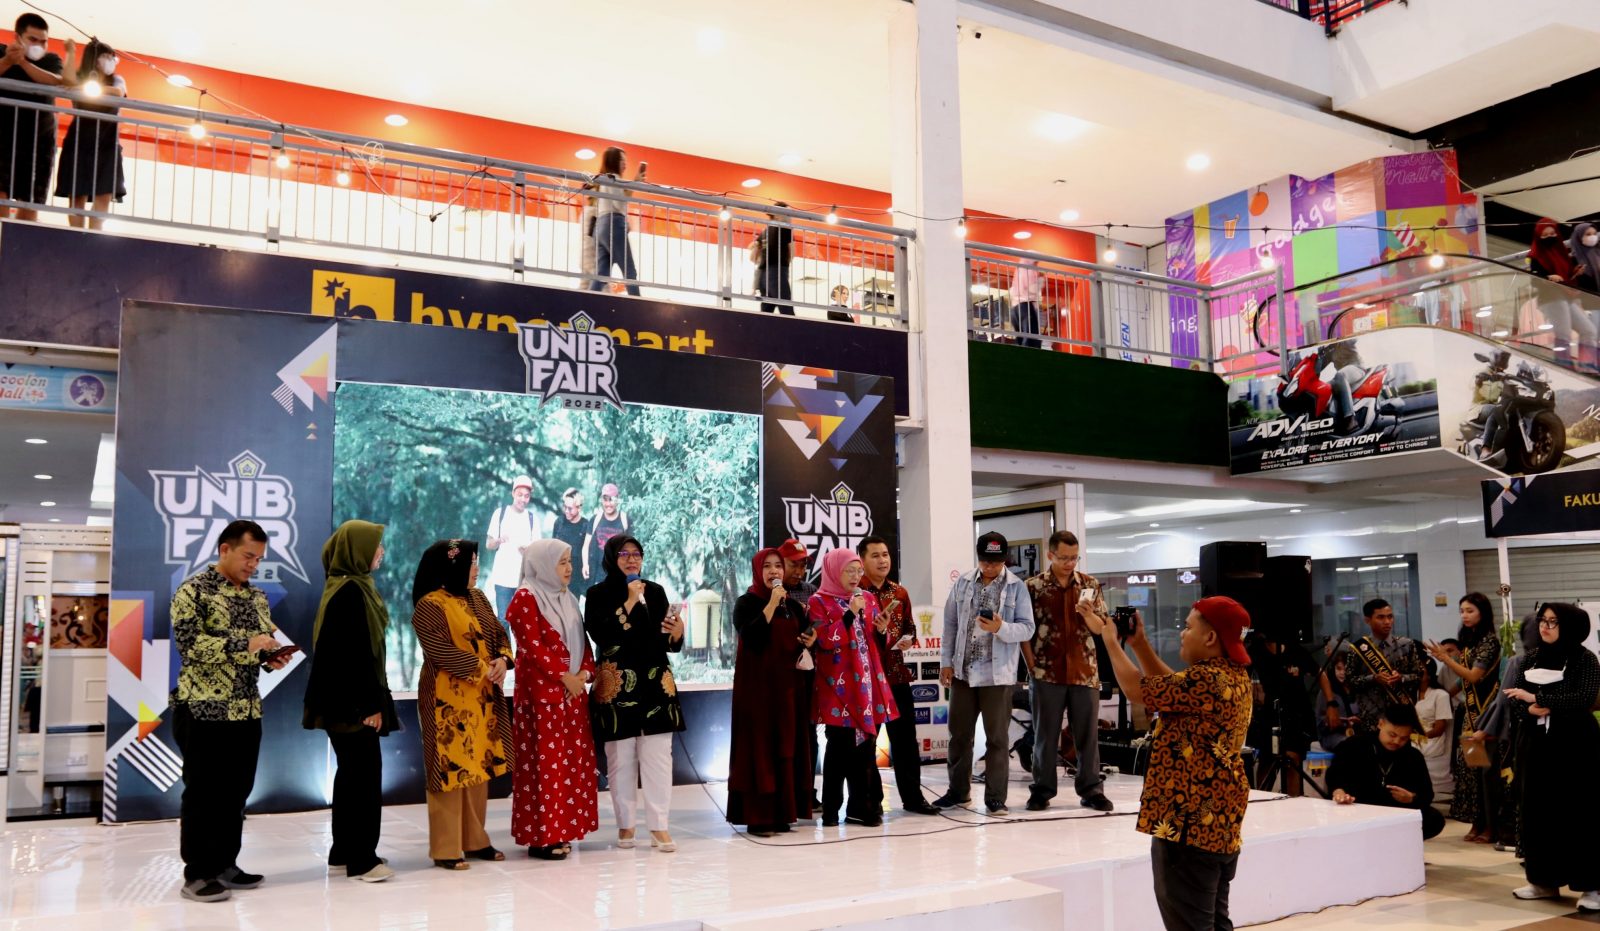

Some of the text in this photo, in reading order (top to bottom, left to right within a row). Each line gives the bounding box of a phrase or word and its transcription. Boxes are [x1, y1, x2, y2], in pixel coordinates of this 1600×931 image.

[523, 328, 611, 363] UNIB
[0, 388, 24, 399] all
[531, 358, 619, 402] FAIR
[565, 399, 602, 409] 2022
[1262, 444, 1309, 460] EXPLORE
[1321, 432, 1383, 450] EVERYDAY
[1324, 452, 1348, 461] DISTANCE
[1350, 448, 1374, 457] COMFORT
[161, 476, 289, 519] UNIB
[790, 502, 870, 536] UNIB
